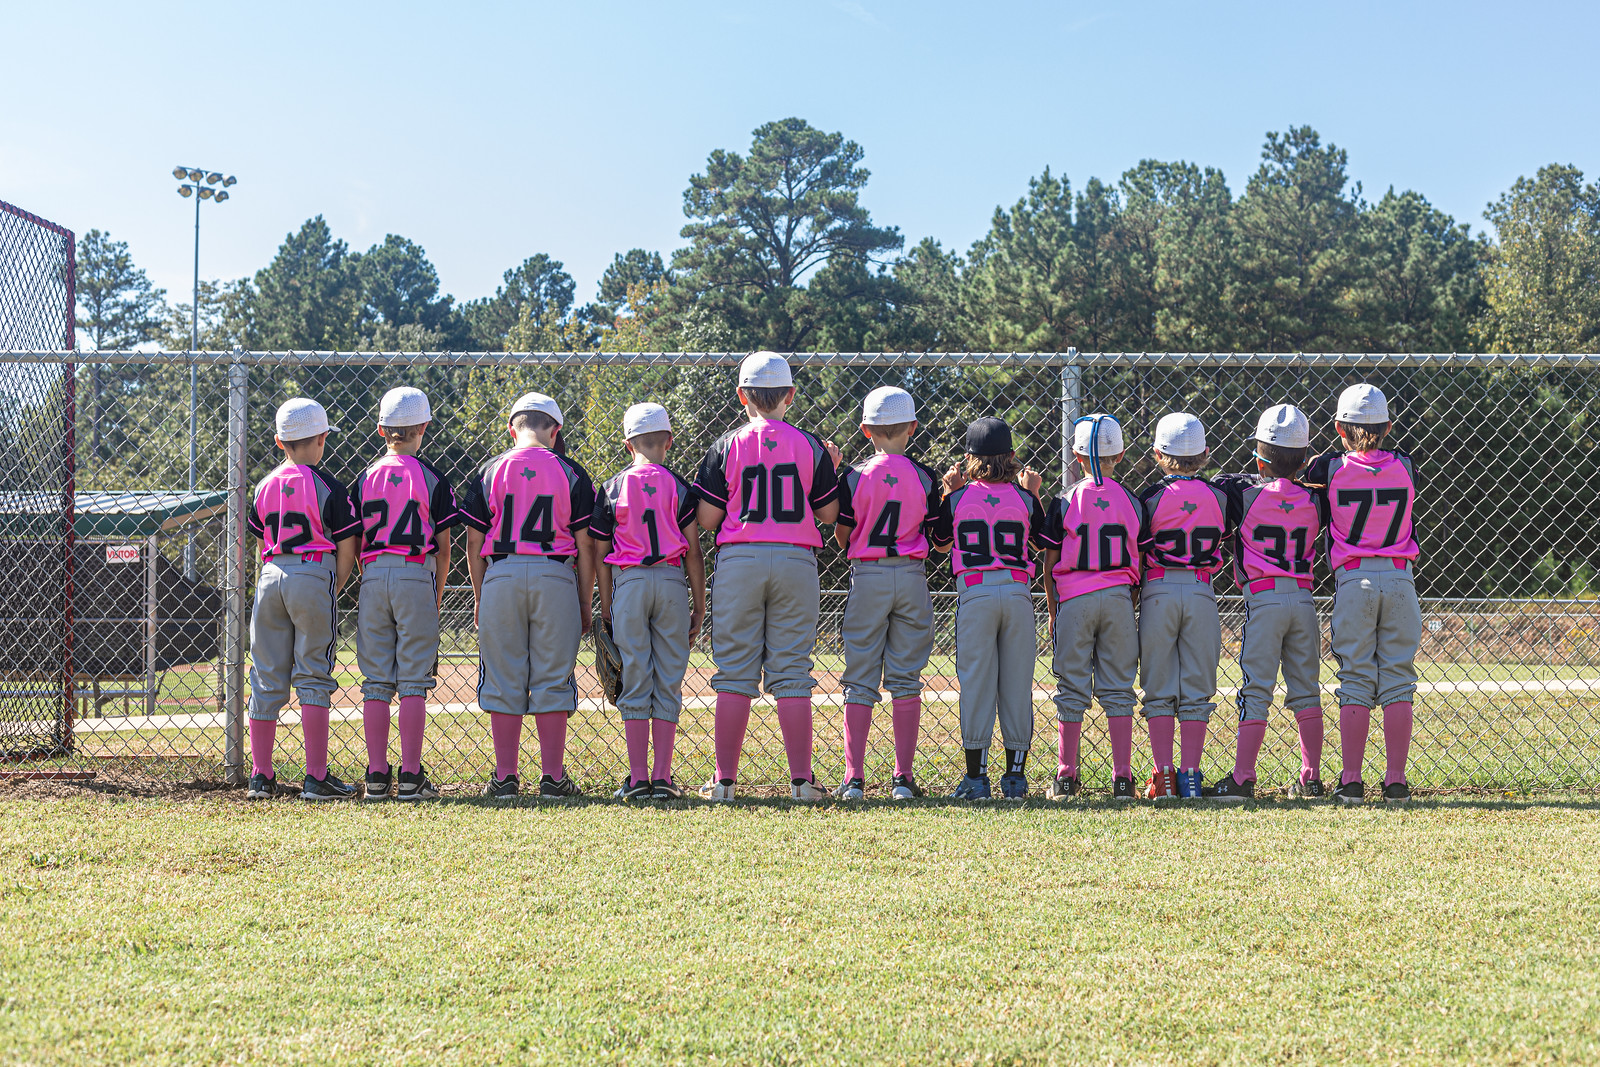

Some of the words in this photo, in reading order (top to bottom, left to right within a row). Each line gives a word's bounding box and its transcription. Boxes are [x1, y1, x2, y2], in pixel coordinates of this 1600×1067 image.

[739, 462, 805, 524] 00
[1336, 487, 1409, 549] 77
[265, 511, 314, 554] 12
[361, 499, 427, 557] 24
[493, 494, 555, 554] 14
[640, 509, 667, 567] 1
[867, 500, 902, 558] 4
[957, 519, 1028, 569] 99
[1072, 523, 1132, 571] 10
[1154, 526, 1223, 568] 28
[1252, 524, 1309, 575] 31
